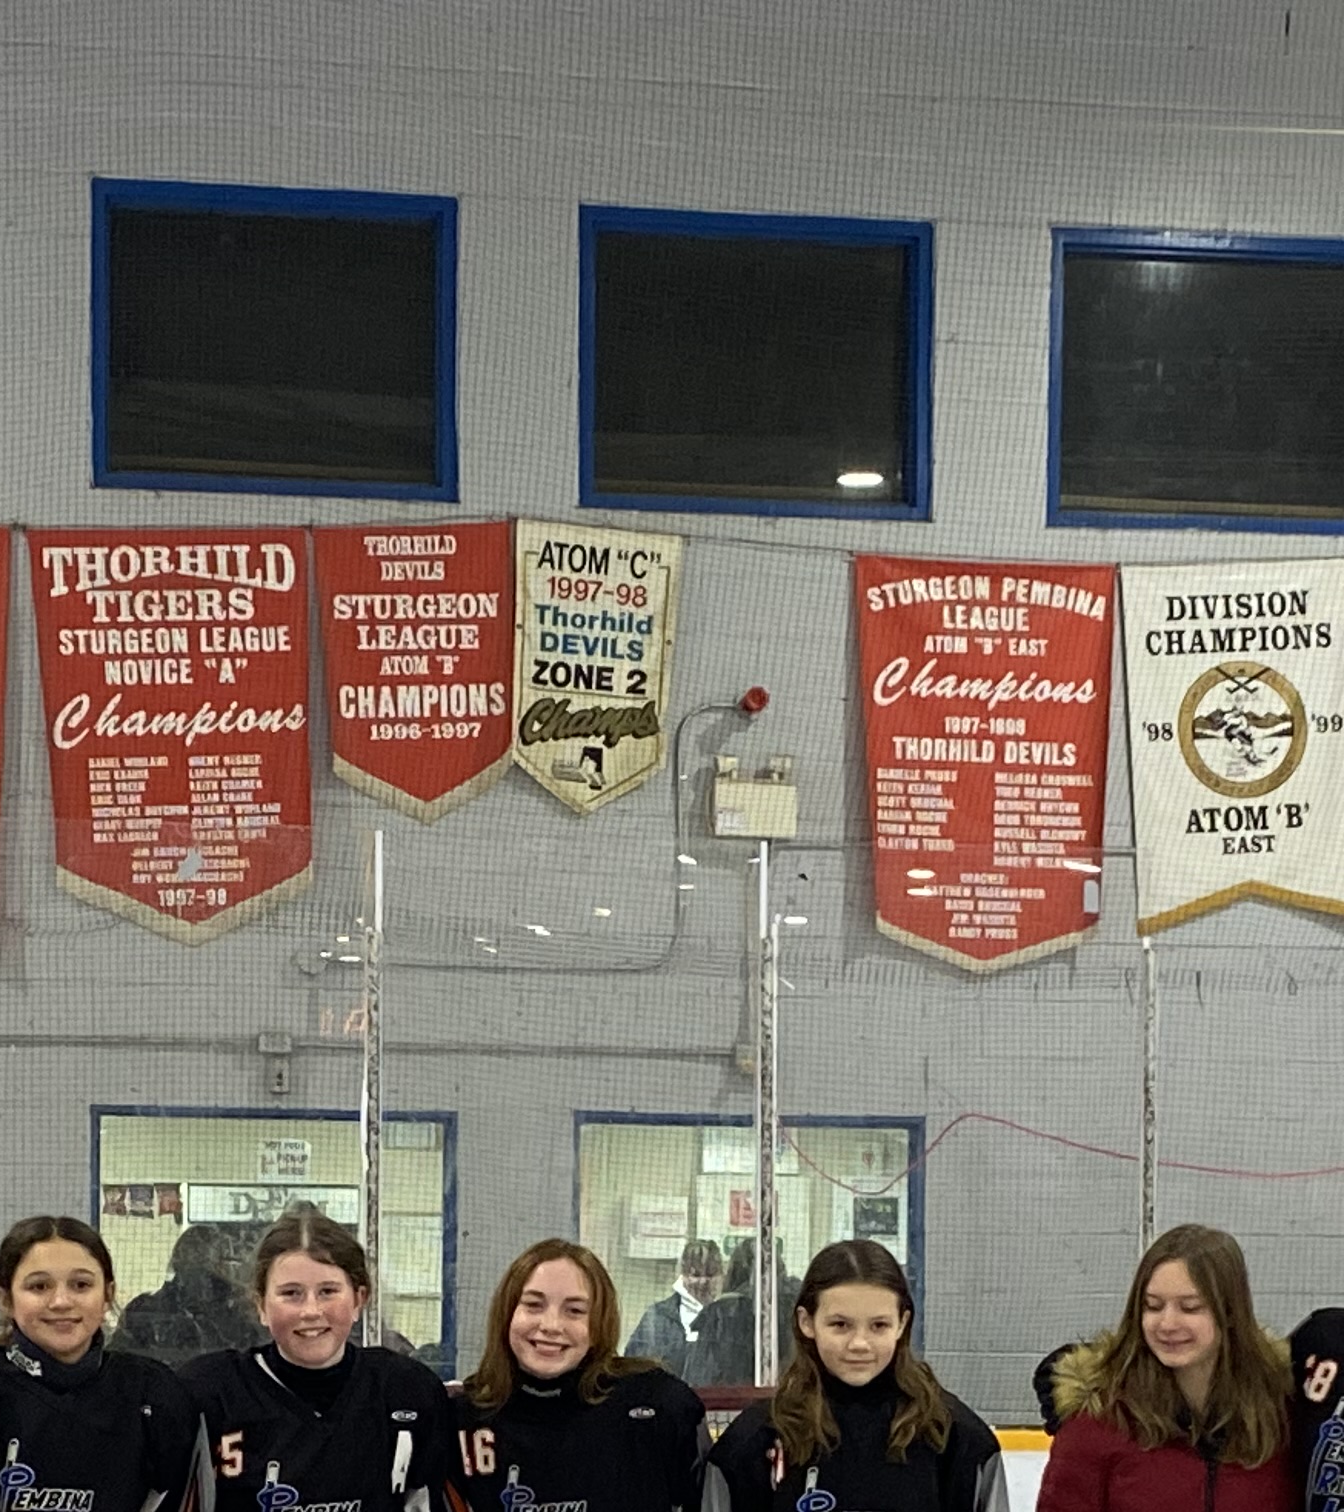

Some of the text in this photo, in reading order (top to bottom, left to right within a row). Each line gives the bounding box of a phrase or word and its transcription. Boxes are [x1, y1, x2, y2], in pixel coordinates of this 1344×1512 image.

[364, 535, 457, 557] THORHILD
[537, 540, 610, 577] ATOM
[42, 543, 296, 598] THORHILD
[380, 560, 445, 581] DEVILS
[86, 587, 255, 623] TIGERS
[332, 592, 500, 620] STURGEON
[546, 575, 648, 608] 1997-98
[867, 574, 1107, 622] STURGEON PEMBINA
[1165, 590, 1309, 622] DIVISION
[534, 604, 654, 636] Thorhild
[942, 605, 1030, 632] LEAGUE
[58, 625, 292, 656] STURGEON LEAGUE
[356, 624, 480, 651] LEAGUE
[539, 631, 645, 662] DEVILS
[924, 635, 1048, 657] ATOM EAST
[1145, 622, 1332, 656] CHAMPIONS
[105, 658, 194, 686] NOVICE
[379, 655, 429, 677] ATOM
[531, 659, 647, 695] ZONE 2
[873, 656, 1097, 711] Champions
[339, 682, 506, 720] CHAMPIONS
[53, 693, 306, 750] Champions
[519, 698, 660, 748] Champs
[892, 736, 1077, 766] THORHILD DEVILS
[1186, 806, 1269, 834] ATOM
[1222, 835, 1275, 856] EAST
